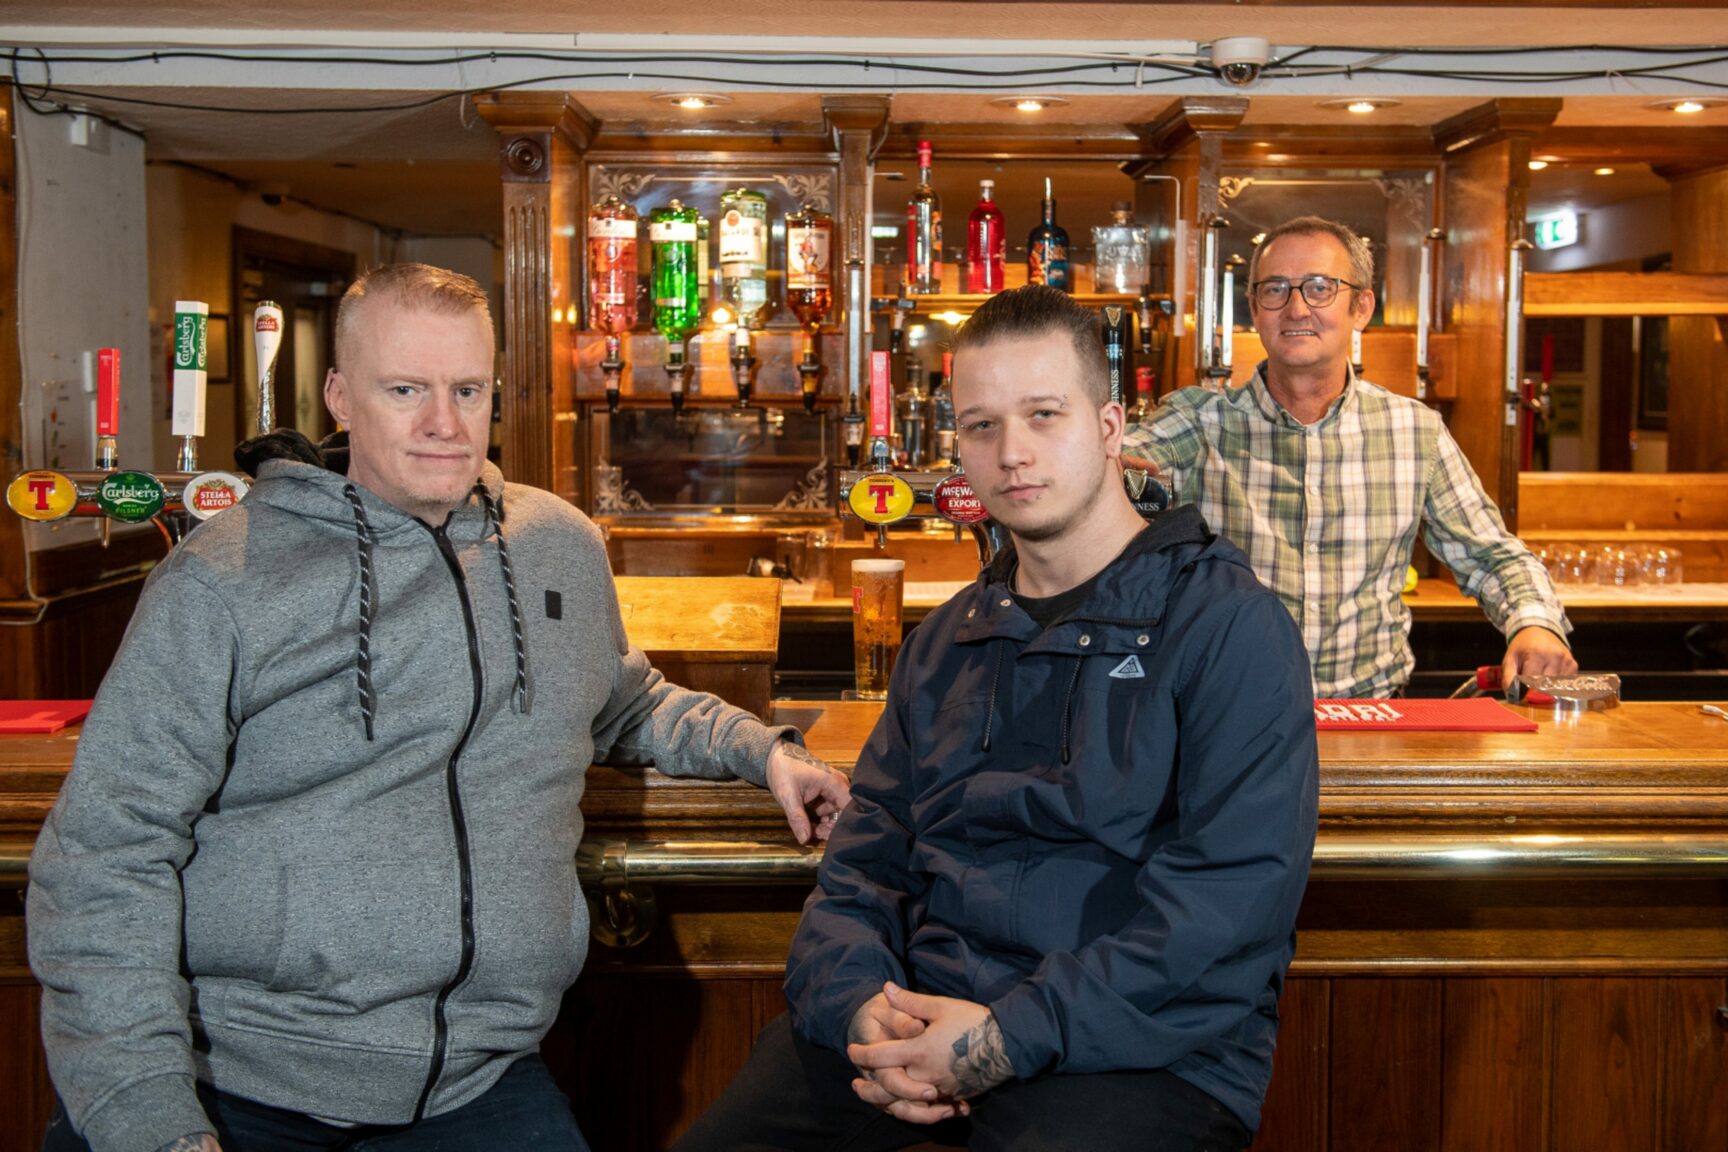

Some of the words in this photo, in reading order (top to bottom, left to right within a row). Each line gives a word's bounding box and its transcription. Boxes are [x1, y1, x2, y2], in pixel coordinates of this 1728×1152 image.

[176, 316, 195, 366] Carlsberg
[28, 481, 55, 511] T
[102, 483, 160, 504] Carlsberg
[200, 490, 231, 499] STELLA
[200, 498, 232, 507] ARTOIS
[868, 485, 895, 514] T
